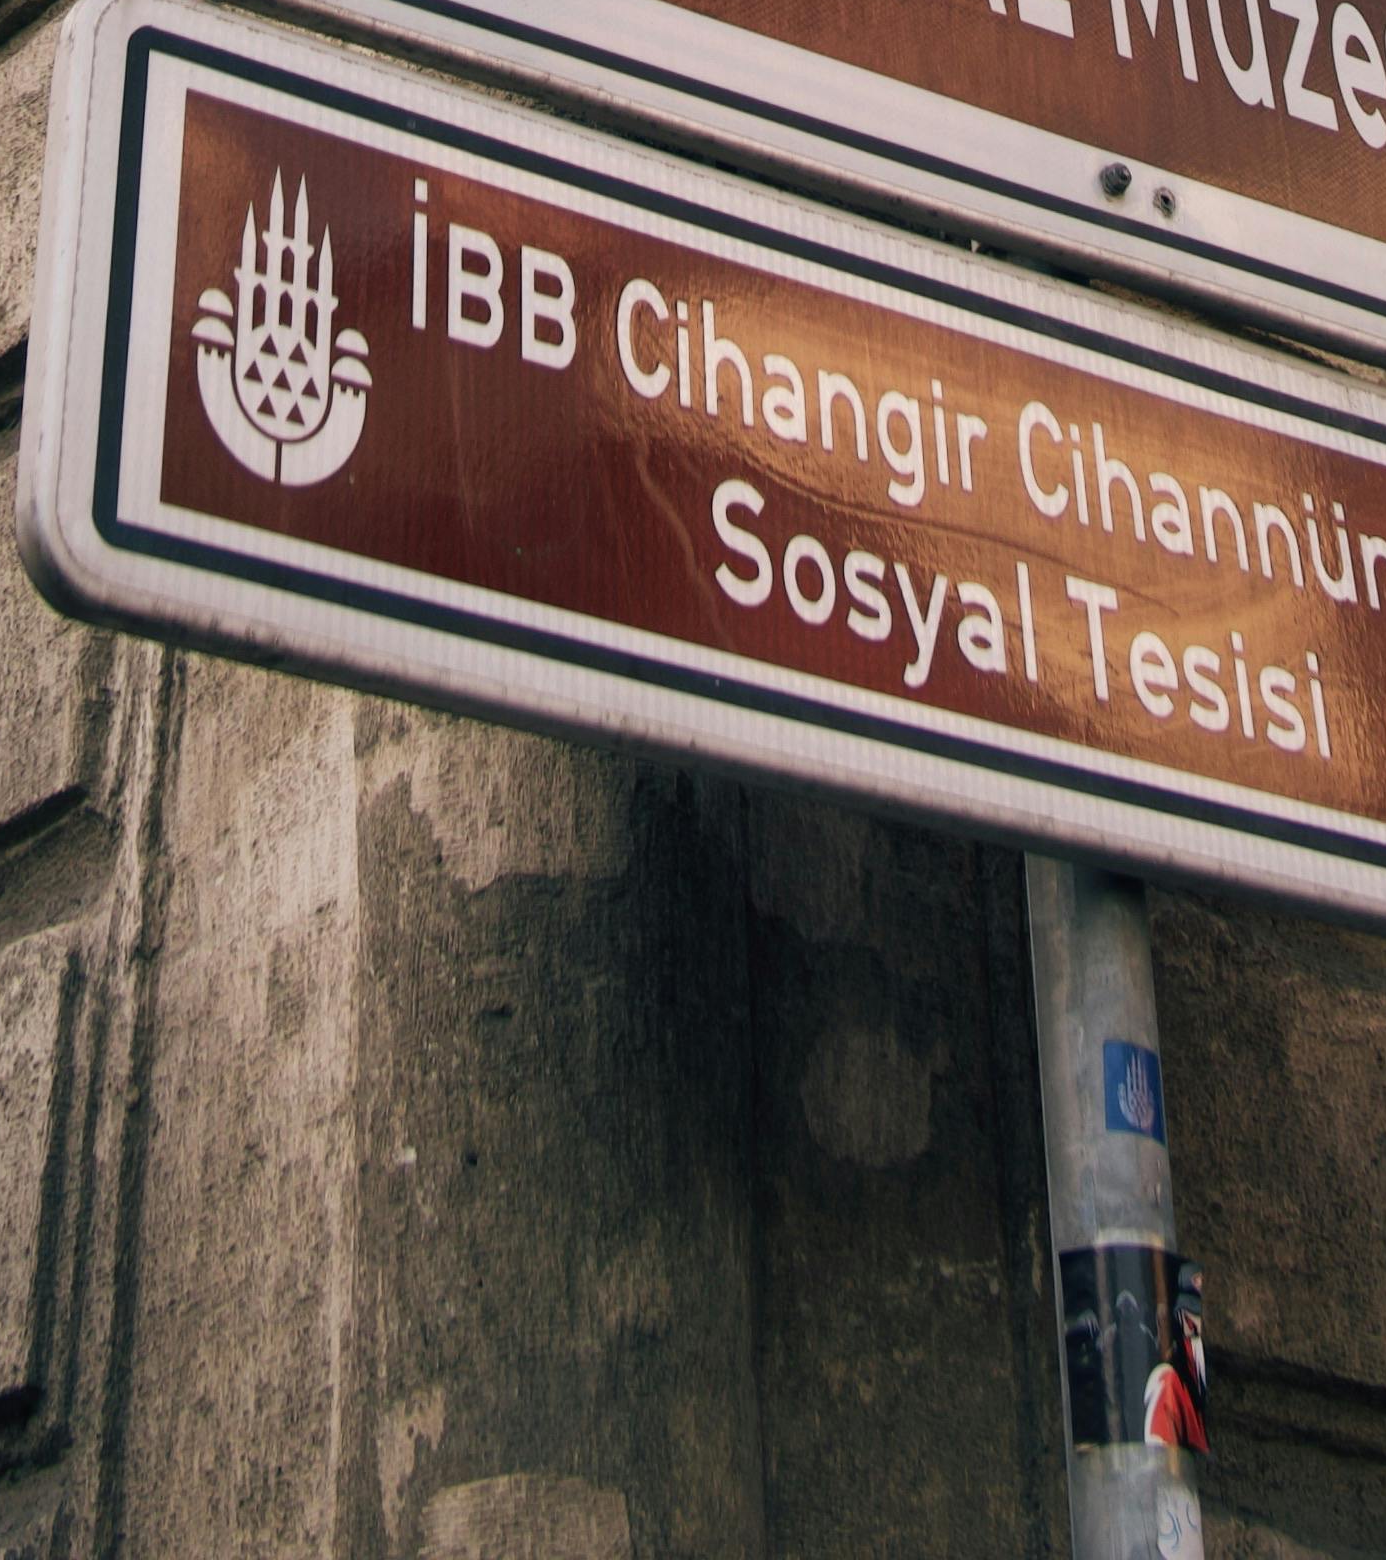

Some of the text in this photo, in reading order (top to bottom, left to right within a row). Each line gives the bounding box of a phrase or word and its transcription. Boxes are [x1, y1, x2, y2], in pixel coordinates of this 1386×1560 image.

[411, 177, 577, 371] İBB
[618, 278, 988, 508] Cihangir
[712, 480, 1329, 760] Sosyal Tesisi
